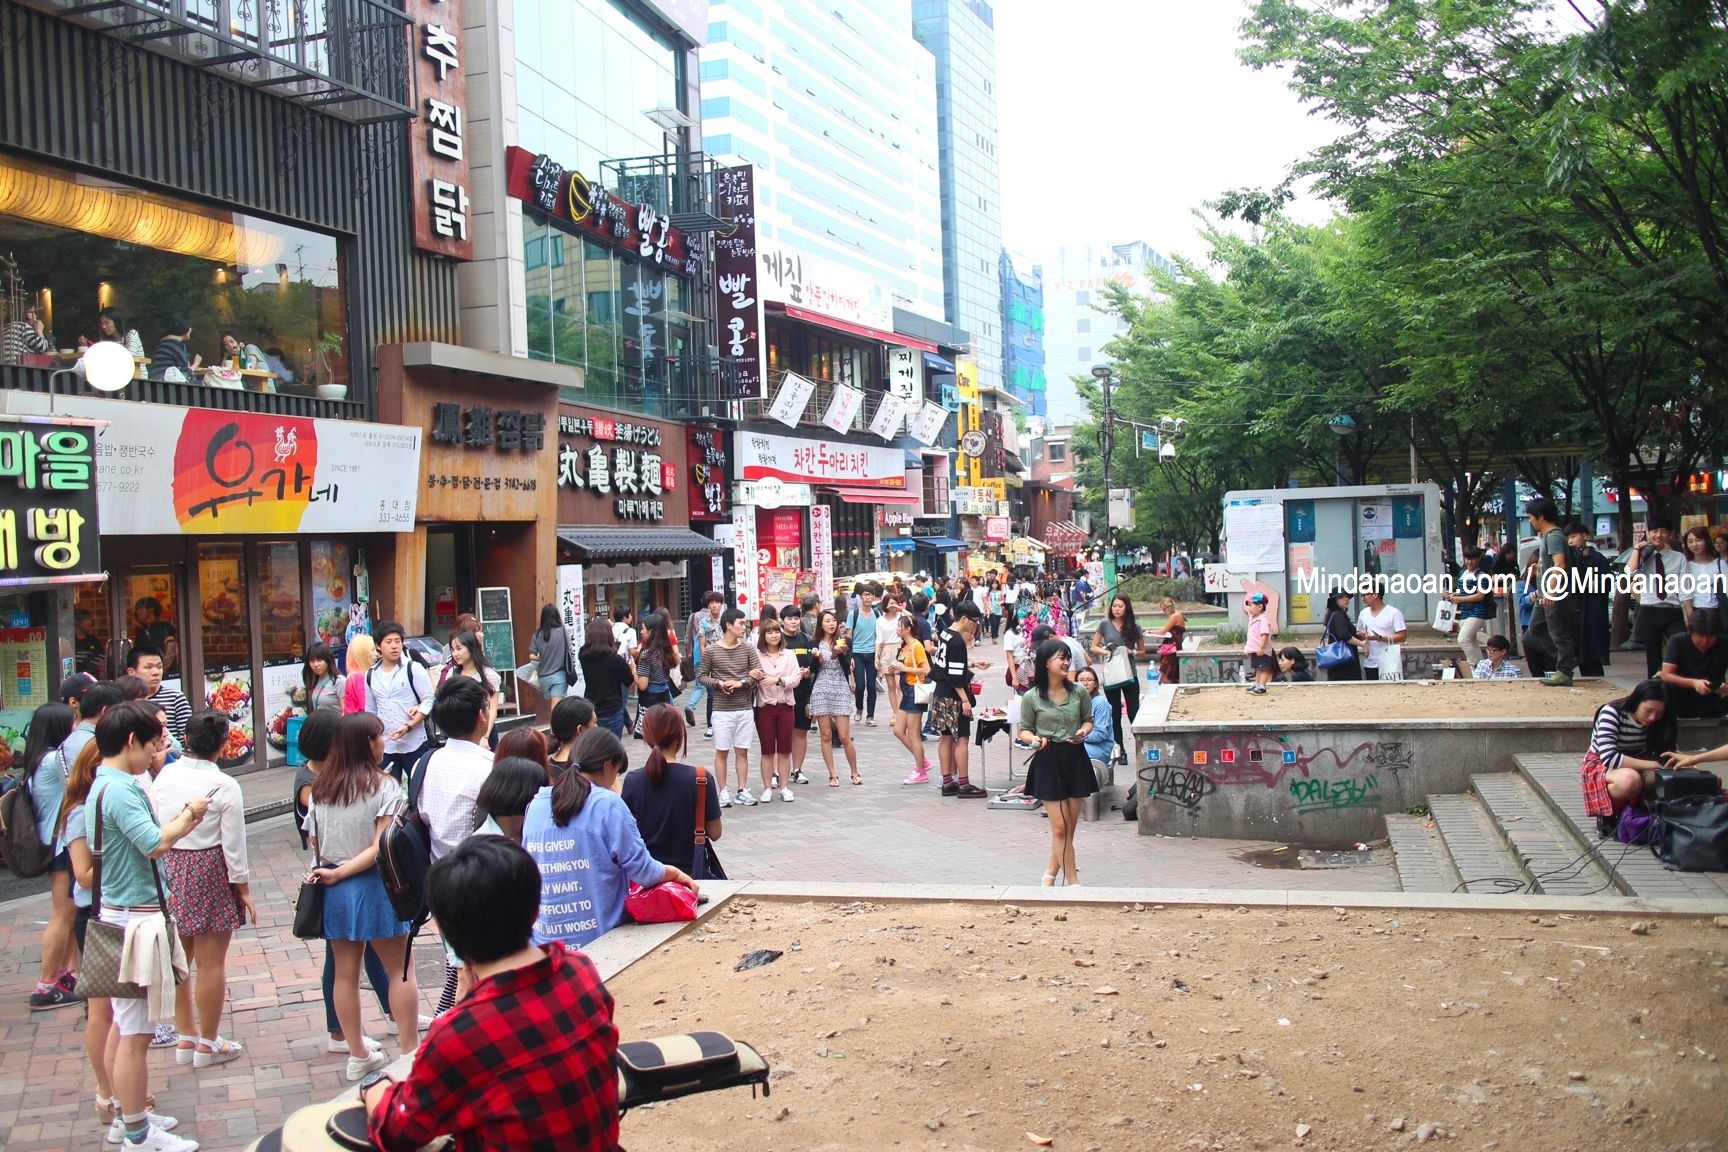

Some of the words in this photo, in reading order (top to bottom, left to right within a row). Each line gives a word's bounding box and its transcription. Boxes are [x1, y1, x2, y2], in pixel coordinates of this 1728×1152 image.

[422, 0, 470, 241] 추찜닭
[793, 446, 816, 474] 차칸
[817, 443, 848, 476] 두마리
[850, 451, 869, 478] 치킨
[188, 421, 339, 518] 유가네
[885, 511, 902, 526] Apple
[1440, 610, 1451, 621] 10
[571, 858, 590, 870] YOU
[552, 881, 583, 894] WANT.
[579, 900, 592, 911] TO
[546, 923, 563, 934] BUT
[564, 919, 597, 932] WORSE
